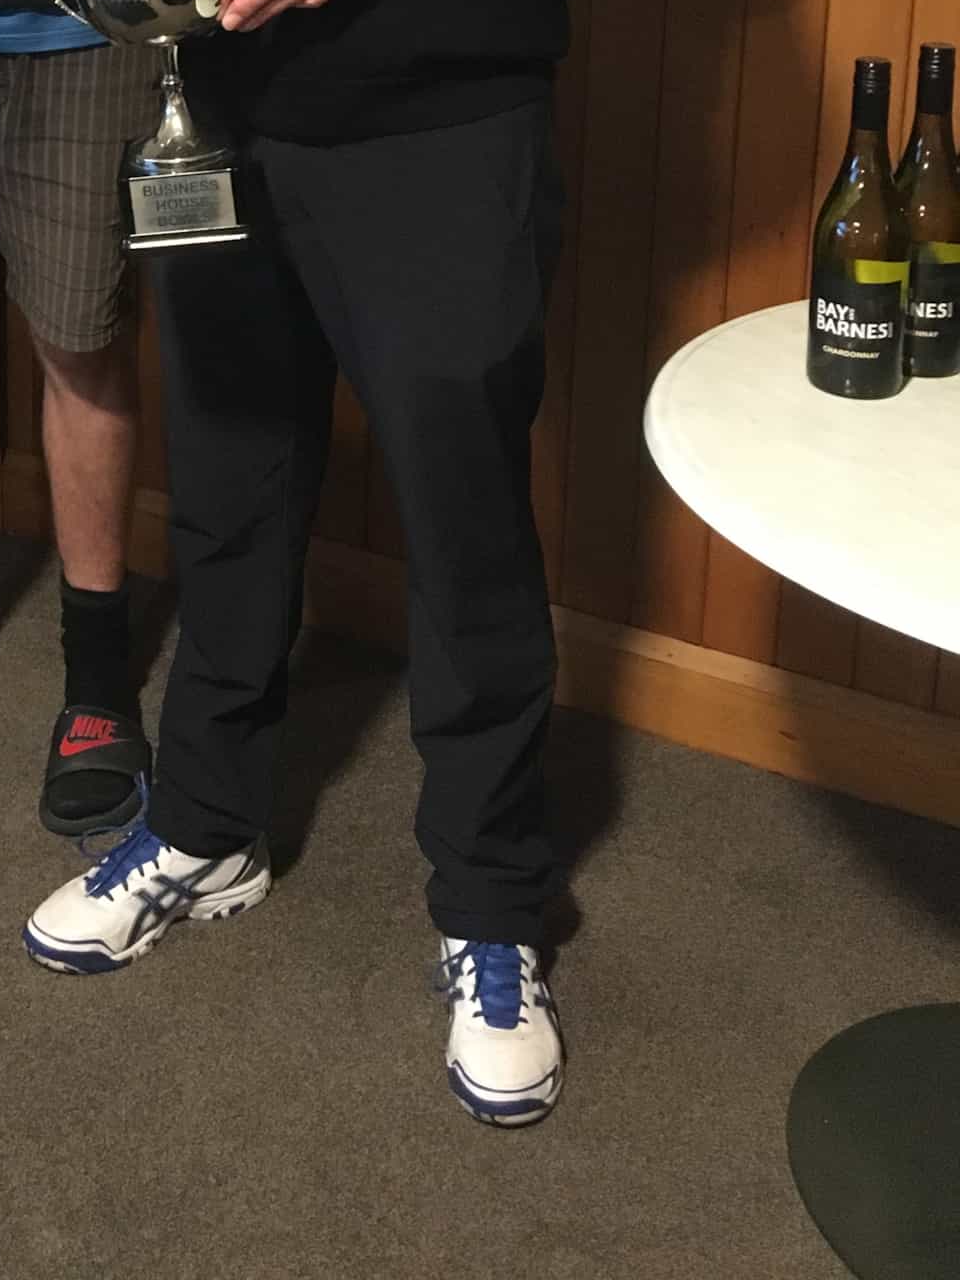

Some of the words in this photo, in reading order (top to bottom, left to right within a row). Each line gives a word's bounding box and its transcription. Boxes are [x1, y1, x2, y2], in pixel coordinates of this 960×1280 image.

[143, 179, 219, 197] BUSINESS
[155, 197, 209, 211] HOUSE
[817, 298, 849, 320] BAY
[817, 314, 888, 339] BARNES
[822, 344, 880, 359] CHARDONNAY
[71, 715, 117, 738] NIKE
